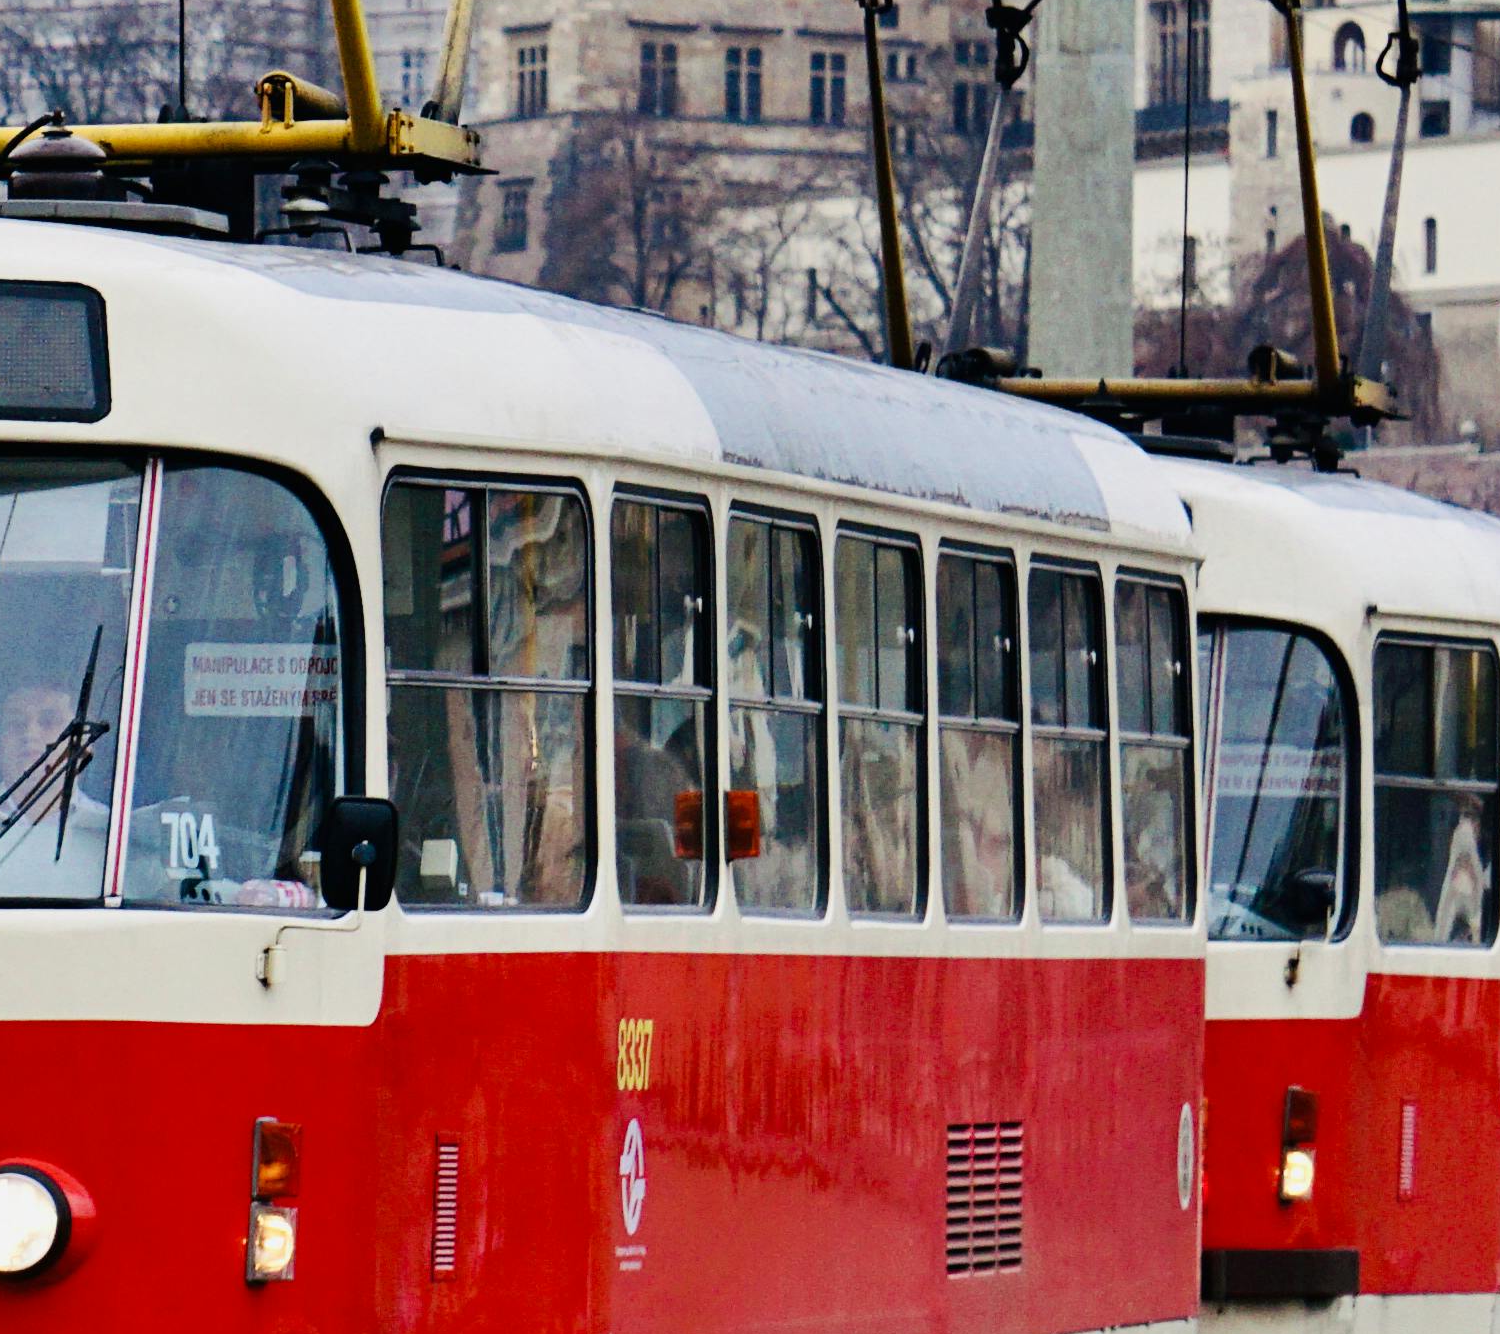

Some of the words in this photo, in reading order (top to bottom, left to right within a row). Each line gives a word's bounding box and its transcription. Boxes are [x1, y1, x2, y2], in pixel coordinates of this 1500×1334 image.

[192, 656, 273, 675] MANIPULACE
[278, 656, 285, 675] S
[191, 689, 216, 707] JEN
[220, 689, 237, 707] SE
[241, 685, 307, 707] STAŽENÝM
[160, 812, 220, 870] 704
[617, 1018, 653, 1091] 8337
